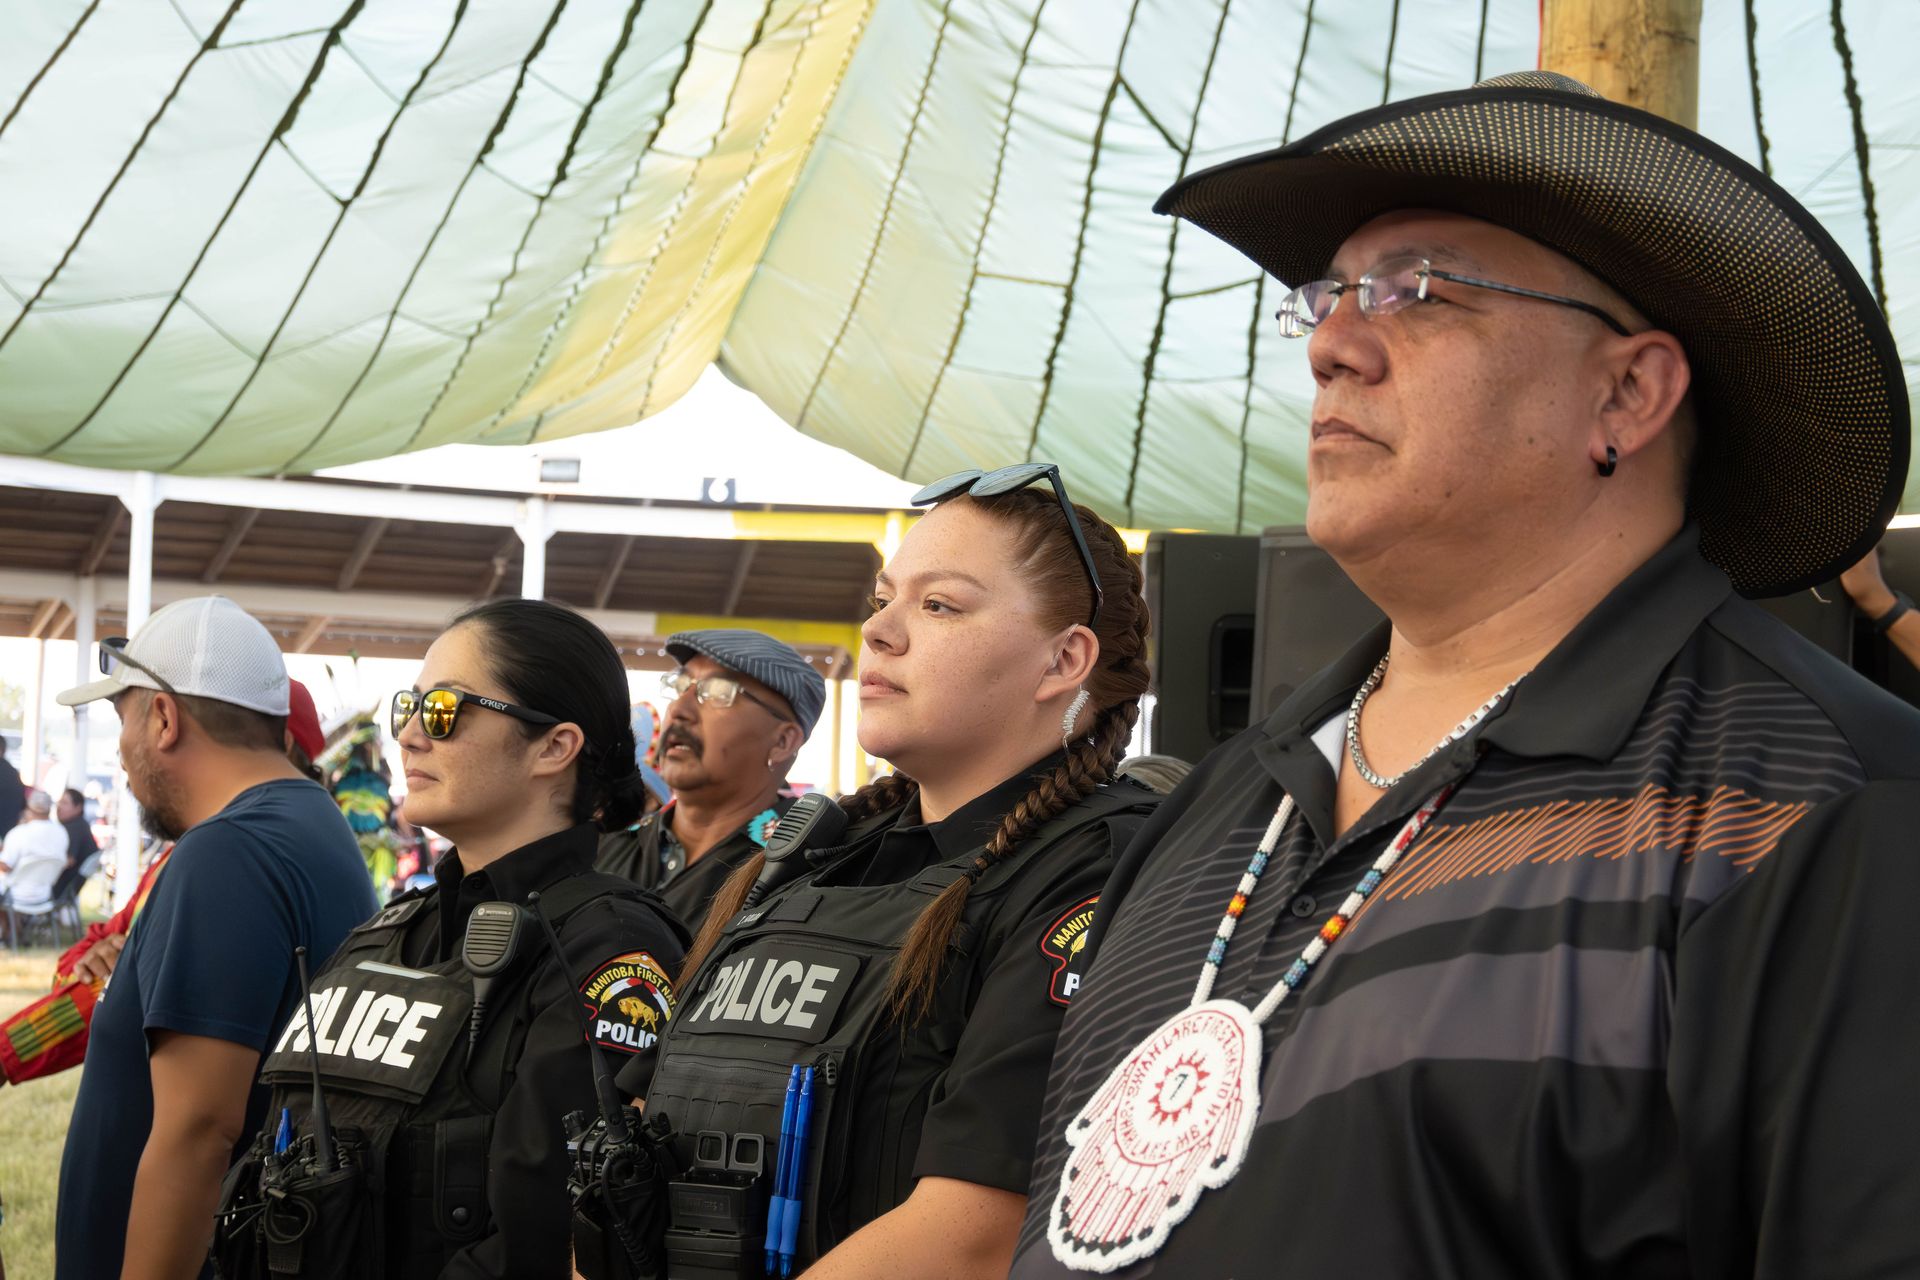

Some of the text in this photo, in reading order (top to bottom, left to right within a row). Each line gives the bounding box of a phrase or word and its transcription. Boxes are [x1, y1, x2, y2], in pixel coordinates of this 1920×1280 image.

[480, 698, 508, 710] OAKLEY
[586, 966, 635, 1000] MANITOBA
[636, 967, 664, 988] FIRST
[689, 957, 840, 1030] POLICE
[275, 986, 443, 1069] POLICE
[1170, 1073, 1189, 1101] 7
